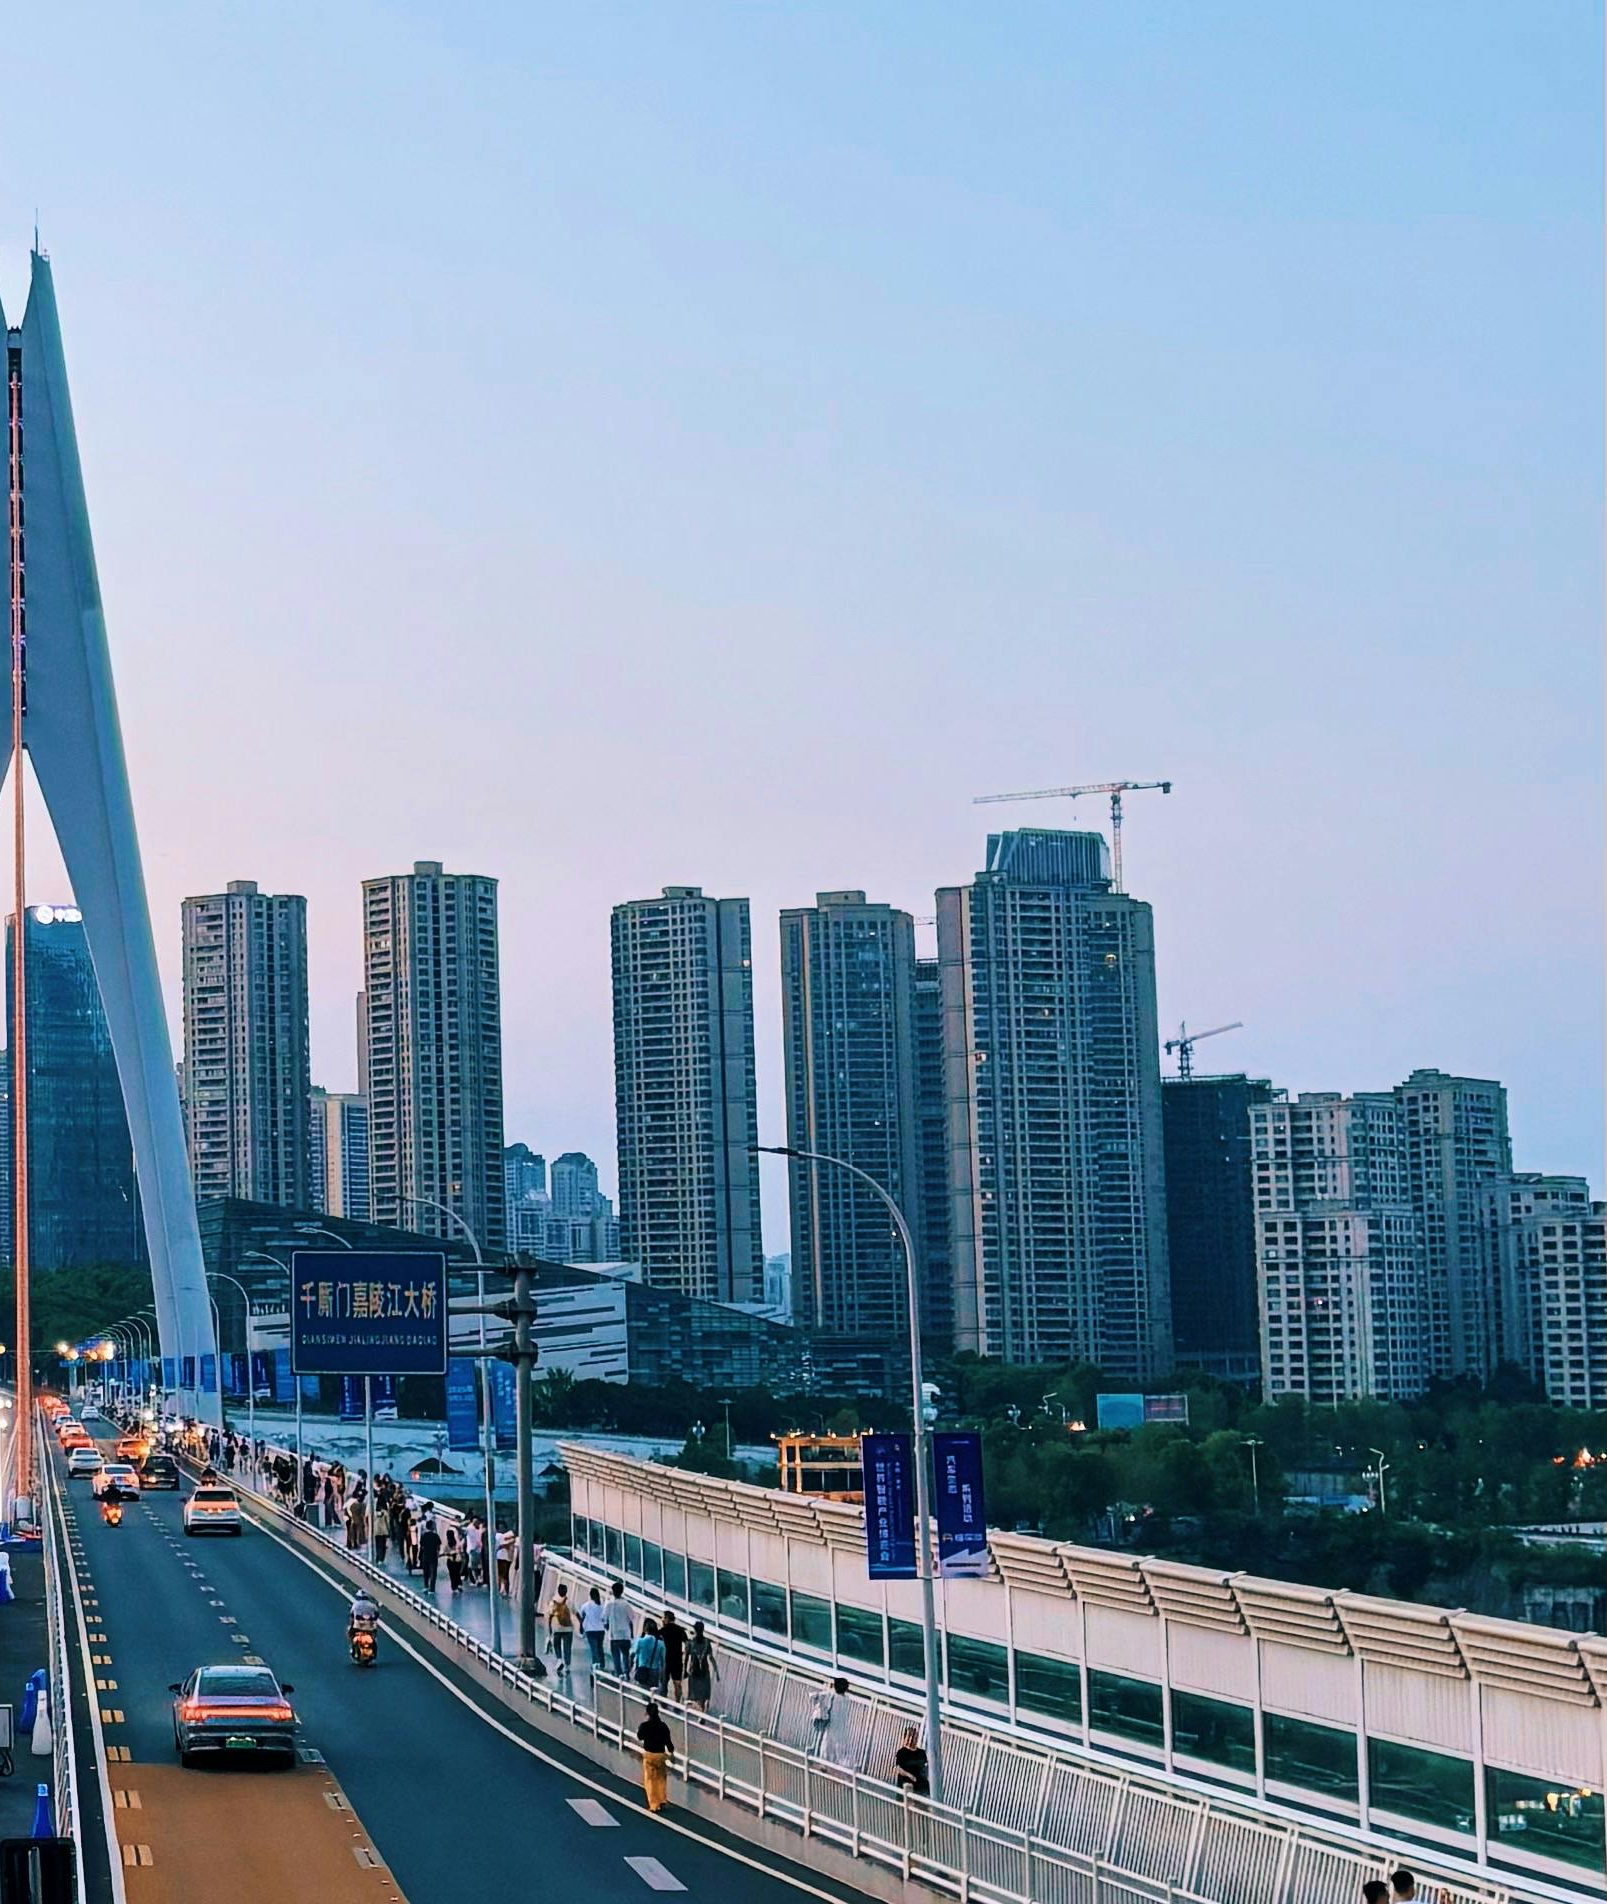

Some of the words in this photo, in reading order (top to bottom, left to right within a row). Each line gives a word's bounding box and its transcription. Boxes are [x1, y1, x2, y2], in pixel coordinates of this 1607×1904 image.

[300, 1280, 437, 1319] 千厮门嘉陵江大桥
